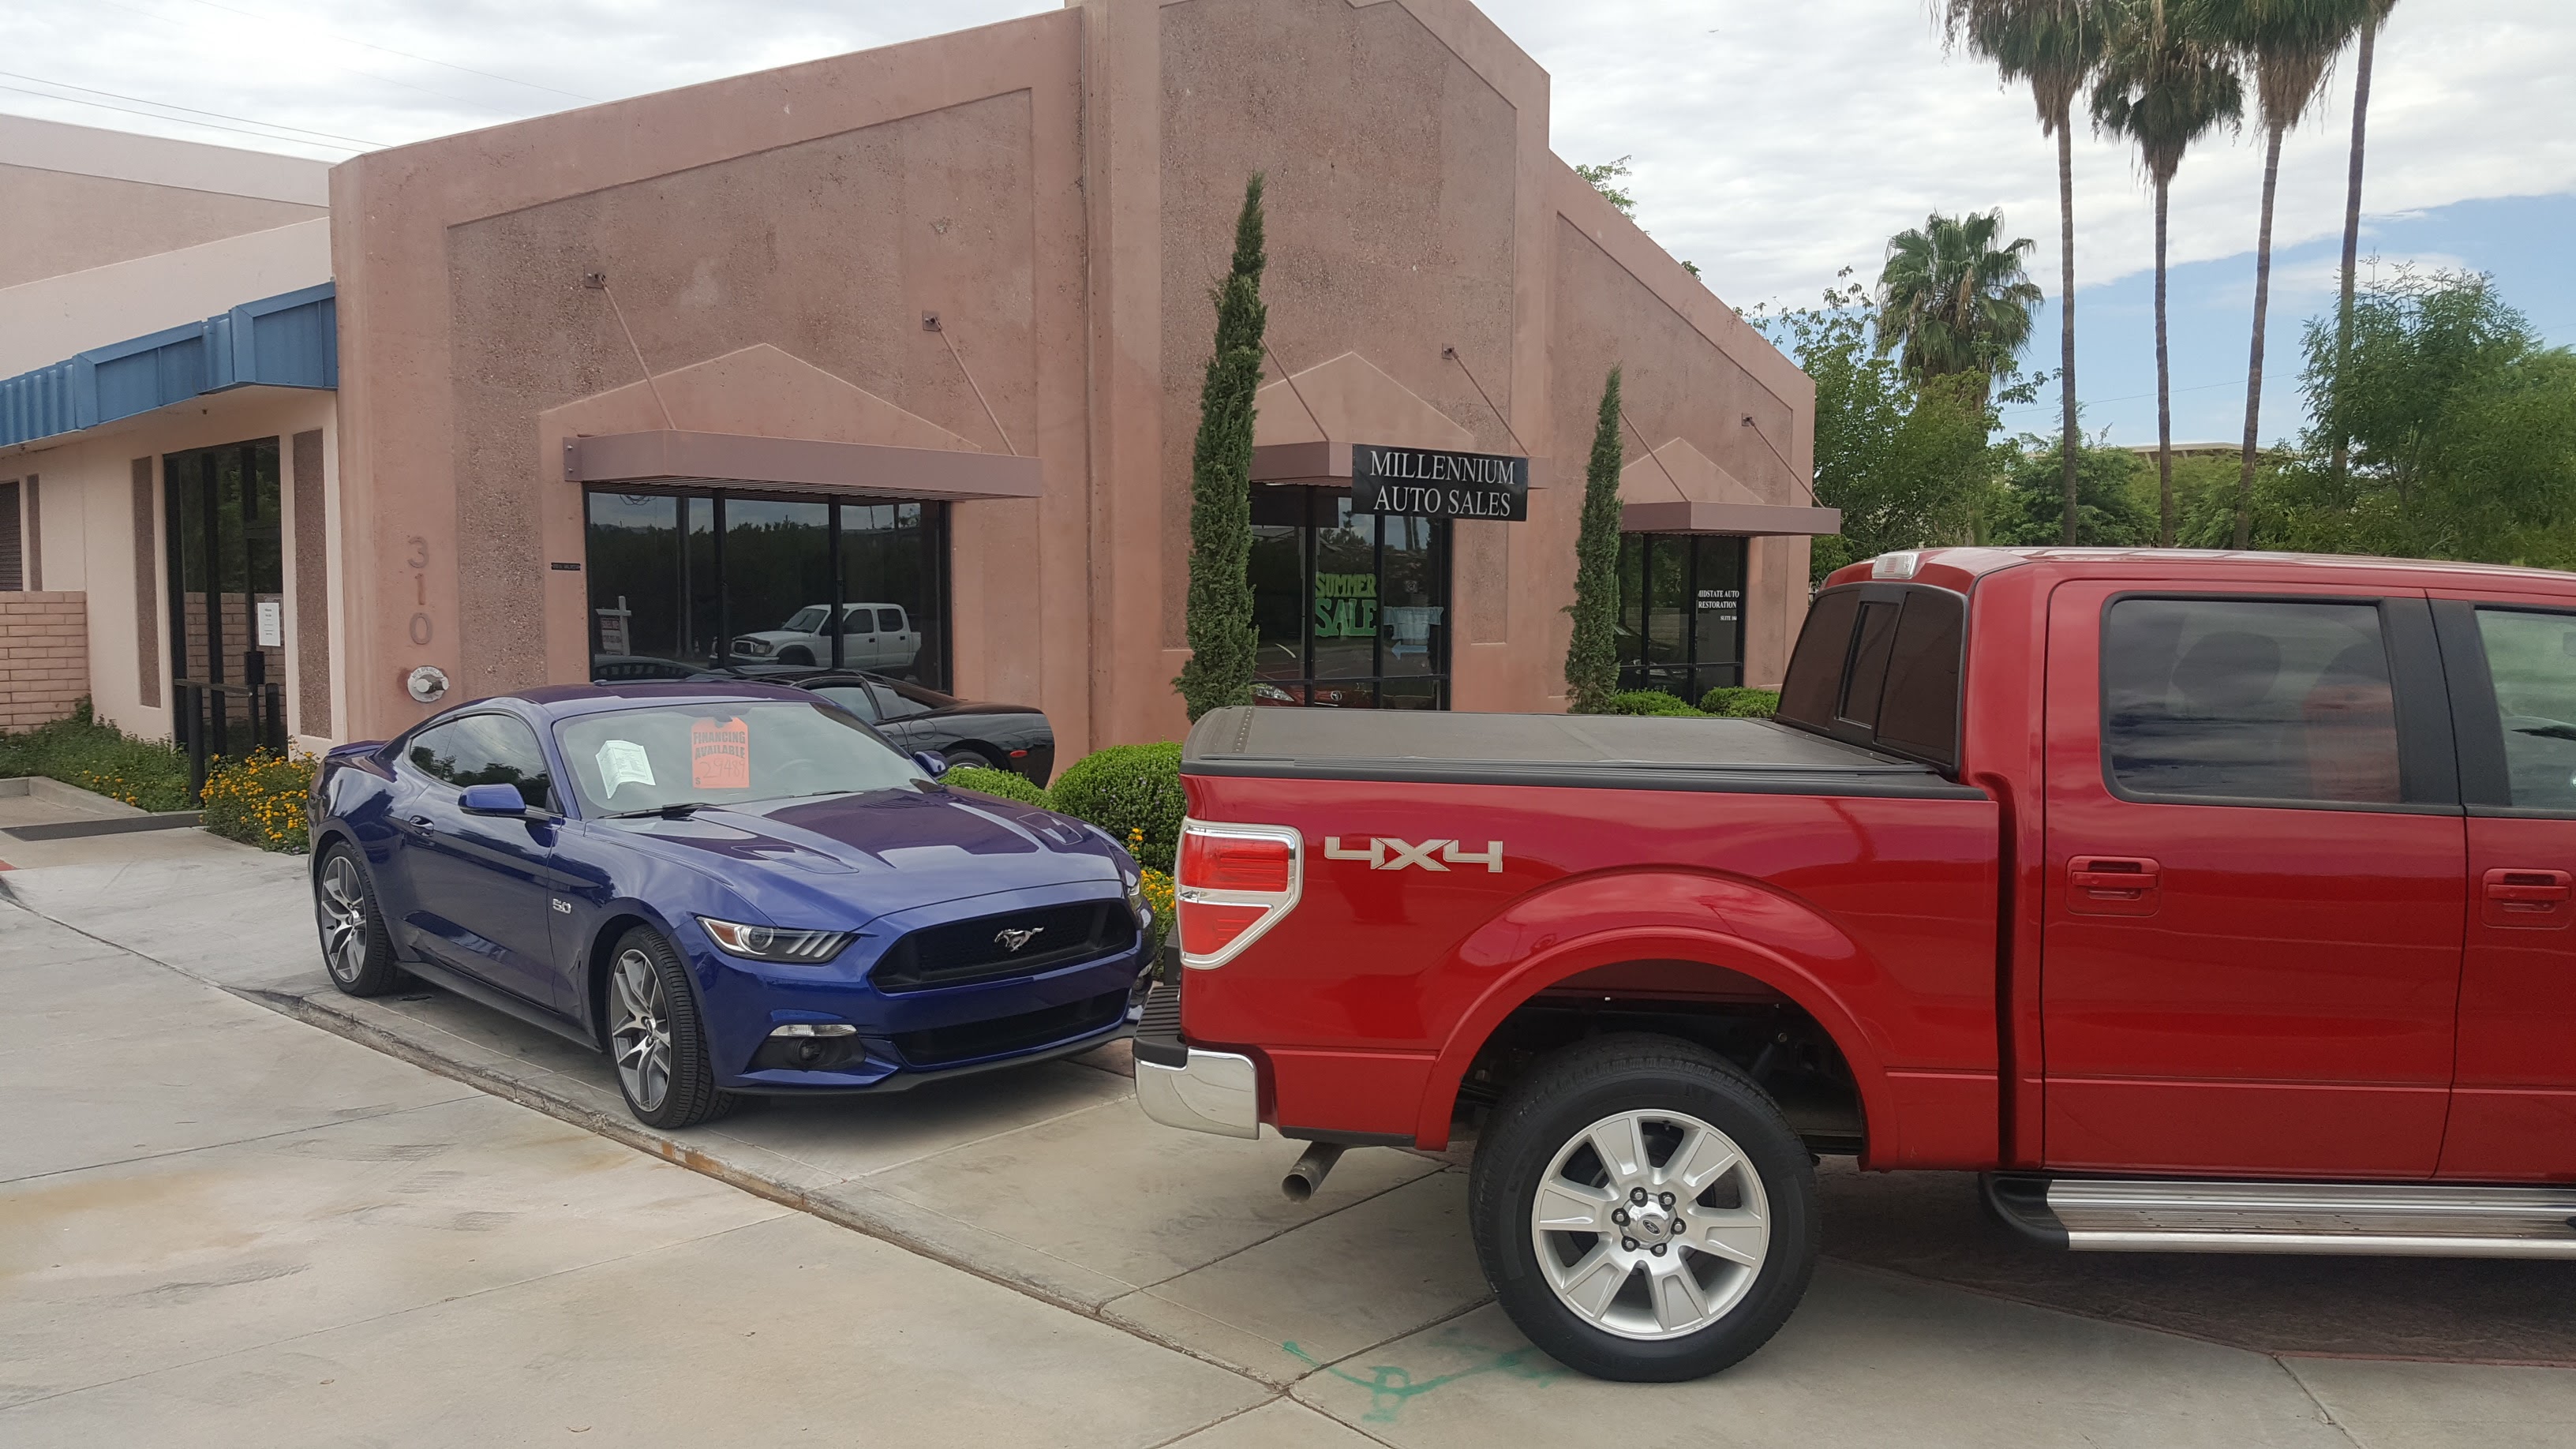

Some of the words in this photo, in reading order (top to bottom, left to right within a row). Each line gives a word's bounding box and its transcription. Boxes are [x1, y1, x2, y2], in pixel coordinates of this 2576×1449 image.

[1369, 450, 1515, 485] MILLENNIUM
[1373, 485, 1442, 514] AUTO
[1447, 489, 1511, 518] SALES
[1315, 571, 1377, 597] SUMMER
[1315, 598, 1377, 637] SALE
[693, 731, 746, 745] FINANCING
[695, 744, 746, 760] AVAILABLE
